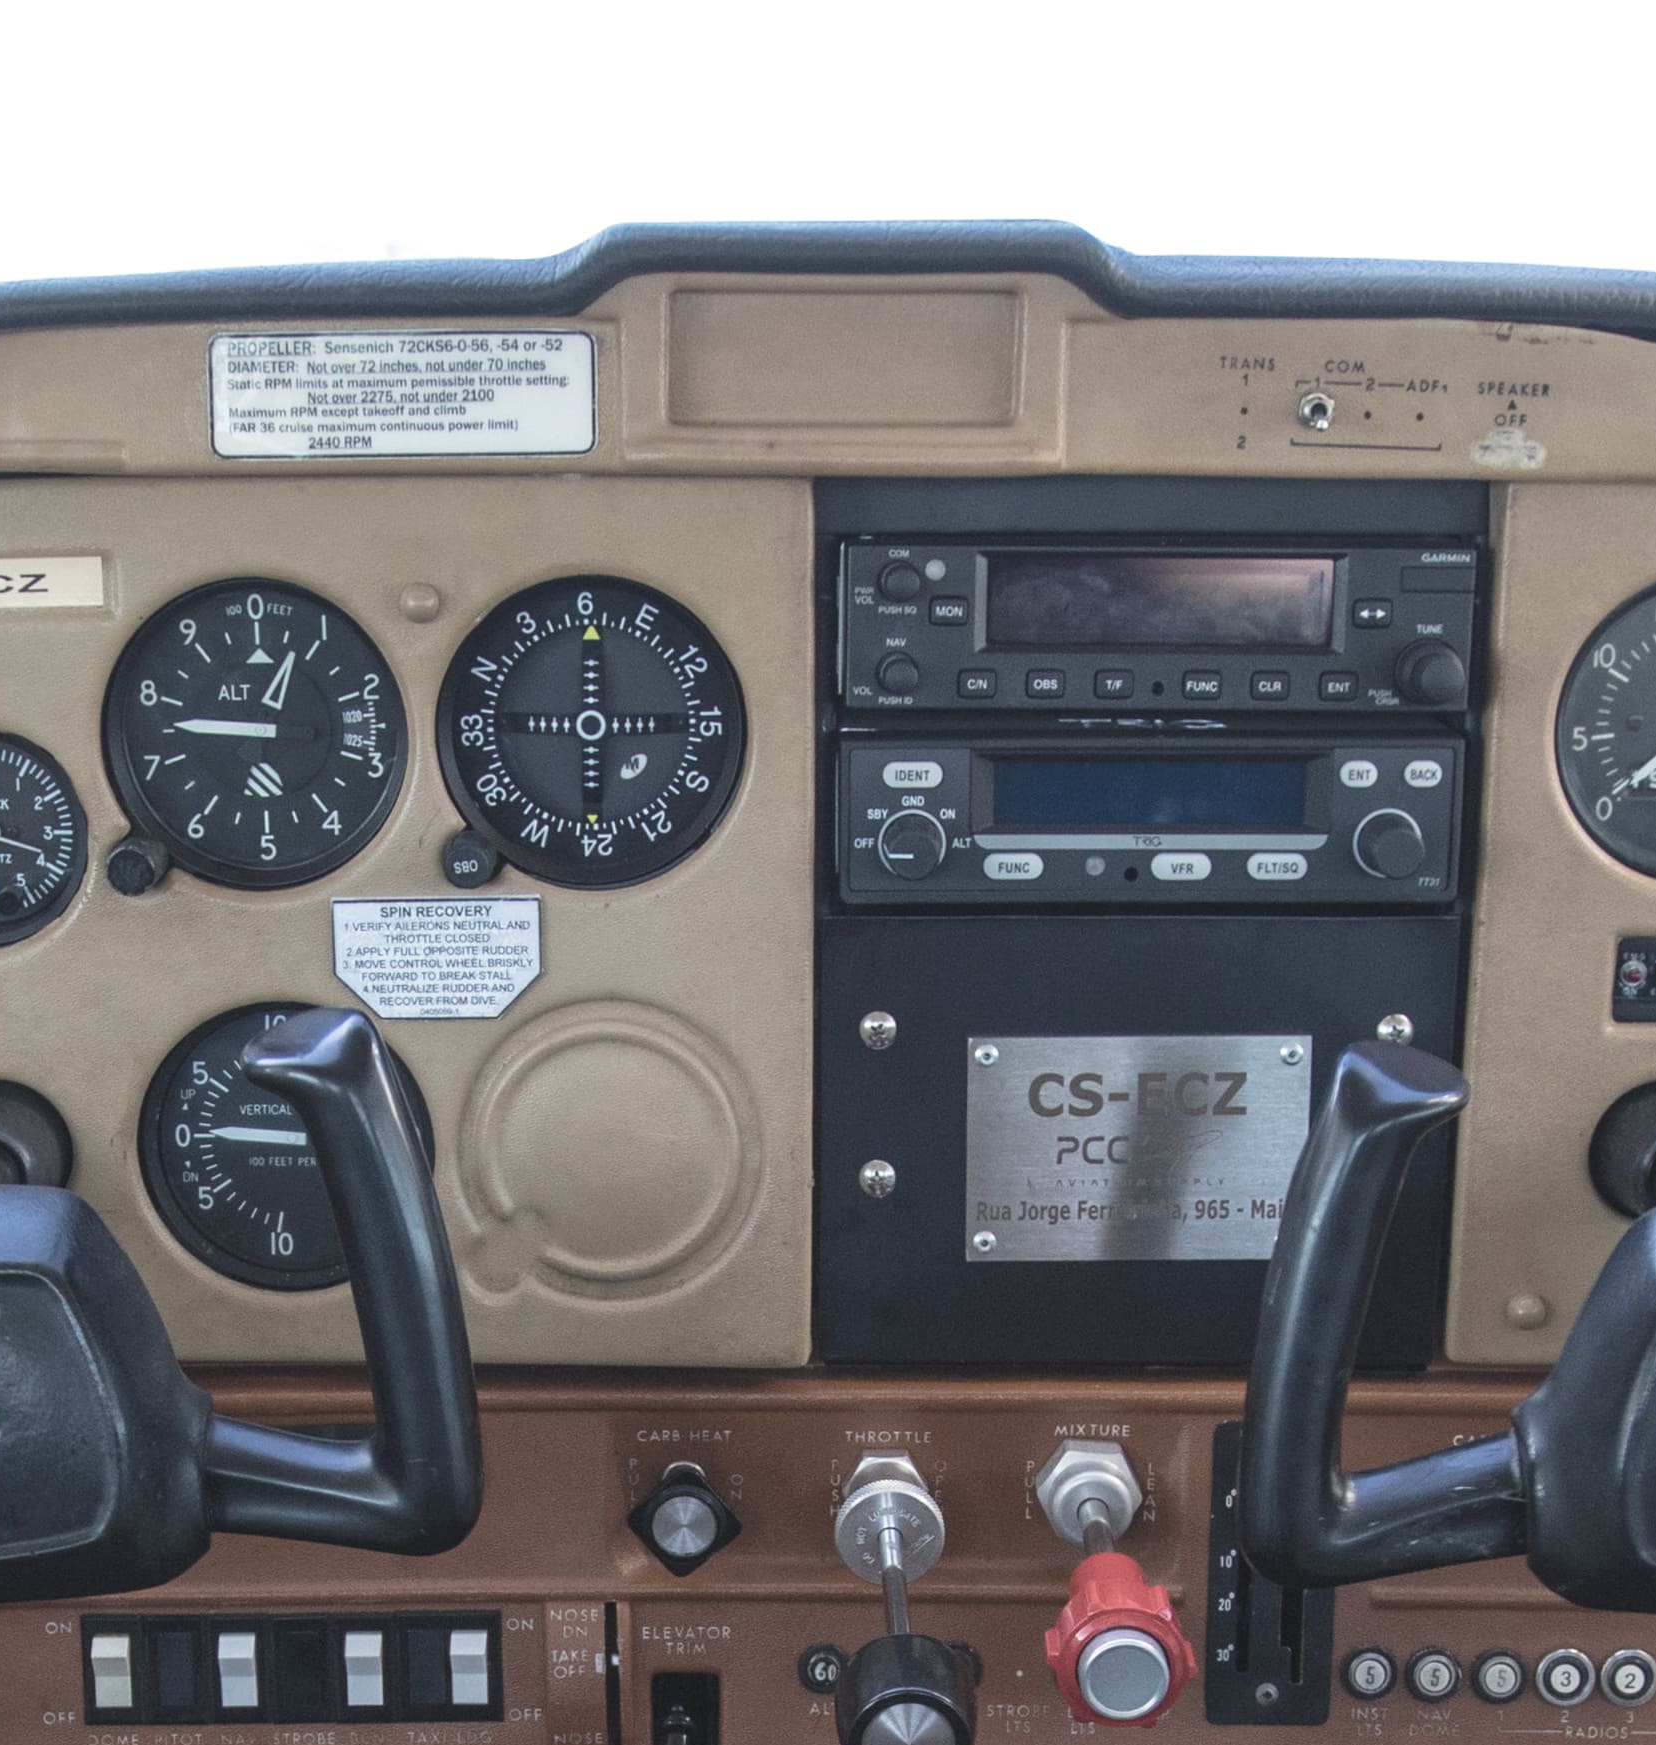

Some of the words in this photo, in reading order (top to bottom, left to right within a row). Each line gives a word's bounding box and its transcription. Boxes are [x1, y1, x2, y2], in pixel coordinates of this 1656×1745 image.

[228, 342, 315, 357] PROPELLER:
[325, 342, 393, 354] Sensenich
[497, 339, 518, 351] -54
[524, 342, 536, 351] or
[541, 339, 562, 351] -52
[228, 361, 298, 373] DIAMETER:
[307, 362, 327, 373] Not
[331, 363, 355, 373] over
[360, 360, 375, 373] 72
[380, 360, 422, 373] inches,
[425, 360, 444, 372] not
[449, 360, 483, 371] under
[488, 359, 503, 371] 70
[508, 359, 546, 370] inches
[1220, 356, 1276, 371] TRANS
[1325, 360, 1366, 373] COM
[1478, 381, 1550, 396] SPEAKER
[1495, 413, 1528, 426] OFF
[309, 437, 340, 449] 2440
[344, 436, 372, 448] RPM
[889, 550, 909, 558] COM
[1421, 553, 1471, 562] GARMIN
[226, 605, 242, 616] 100
[267, 604, 293, 616] FEET
[935, 607, 963, 617] MON
[1416, 624, 1443, 634] TUNE
[886, 638, 906, 647] NAV
[679, 644, 708, 679] 12
[1593, 644, 1616, 669] 10
[363, 674, 380, 700] 2
[967, 679, 988, 690] C/N
[1033, 678, 1058, 691] OBS
[1105, 678, 1124, 692] T/F
[1186, 680, 1218, 693] FUNC
[1258, 680, 1282, 693] CLR
[1328, 682, 1350, 693] ENT
[218, 684, 251, 701] ALT
[700, 706, 723, 737] 15
[460, 714, 484, 746] 33
[895, 770, 930, 781] IDENT
[1348, 769, 1371, 780] ENT
[1410, 769, 1437, 780] BACK
[476, 773, 507, 806] 30
[901, 796, 925, 806] GND
[867, 809, 888, 819] SBY
[940, 809, 956, 819] ON
[1595, 797, 1613, 820] 0
[642, 810, 672, 842] 21
[260, 836, 277, 860] 5
[581, 834, 613, 857] 24
[854, 838, 875, 848] OFF
[952, 838, 971, 848] ALT
[454, 860, 478, 874] OBS
[998, 860, 1030, 875] FUNC
[1170, 861, 1194, 875] VFR
[1257, 860, 1300, 875] FLT/SQ
[380, 907, 411, 918] SPIN
[416, 906, 492, 917] RECOVERY
[385, 934, 441, 943] THROTTLE
[445, 934, 490, 943] CLOSED
[1028, 1072, 1248, 1117] CS-ECZ
[239, 1104, 292, 1115] VERTICAL
[249, 1157, 265, 1167] 100
[269, 1156, 293, 1167] FEET
[298, 1156, 317, 1167] PER
[976, 1201, 1012, 1221] Rua
[1018, 1200, 1070, 1225] Jorge
[1194, 1199, 1230, 1220] 965
[270, 1232, 293, 1256] 10
[637, 1430, 679, 1443] CARB
[689, 1429, 732, 1442] HEAT
[845, 1430, 932, 1444] THROTTLE
[1054, 1424, 1131, 1437] MIXTURE
[550, 1608, 599, 1623] NOSE
[45, 1622, 73, 1635] ON
[562, 1625, 589, 1638] DN
[641, 1625, 732, 1640] ELEVATOR
[666, 1640, 707, 1656] TRIM
[551, 1650, 590, 1663] TAKE
[553, 1666, 587, 1680] OFF
[43, 1712, 76, 1725] OFF
[1350, 1708, 1389, 1721] INST
[1565, 1725, 1629, 1739] RADIOS
